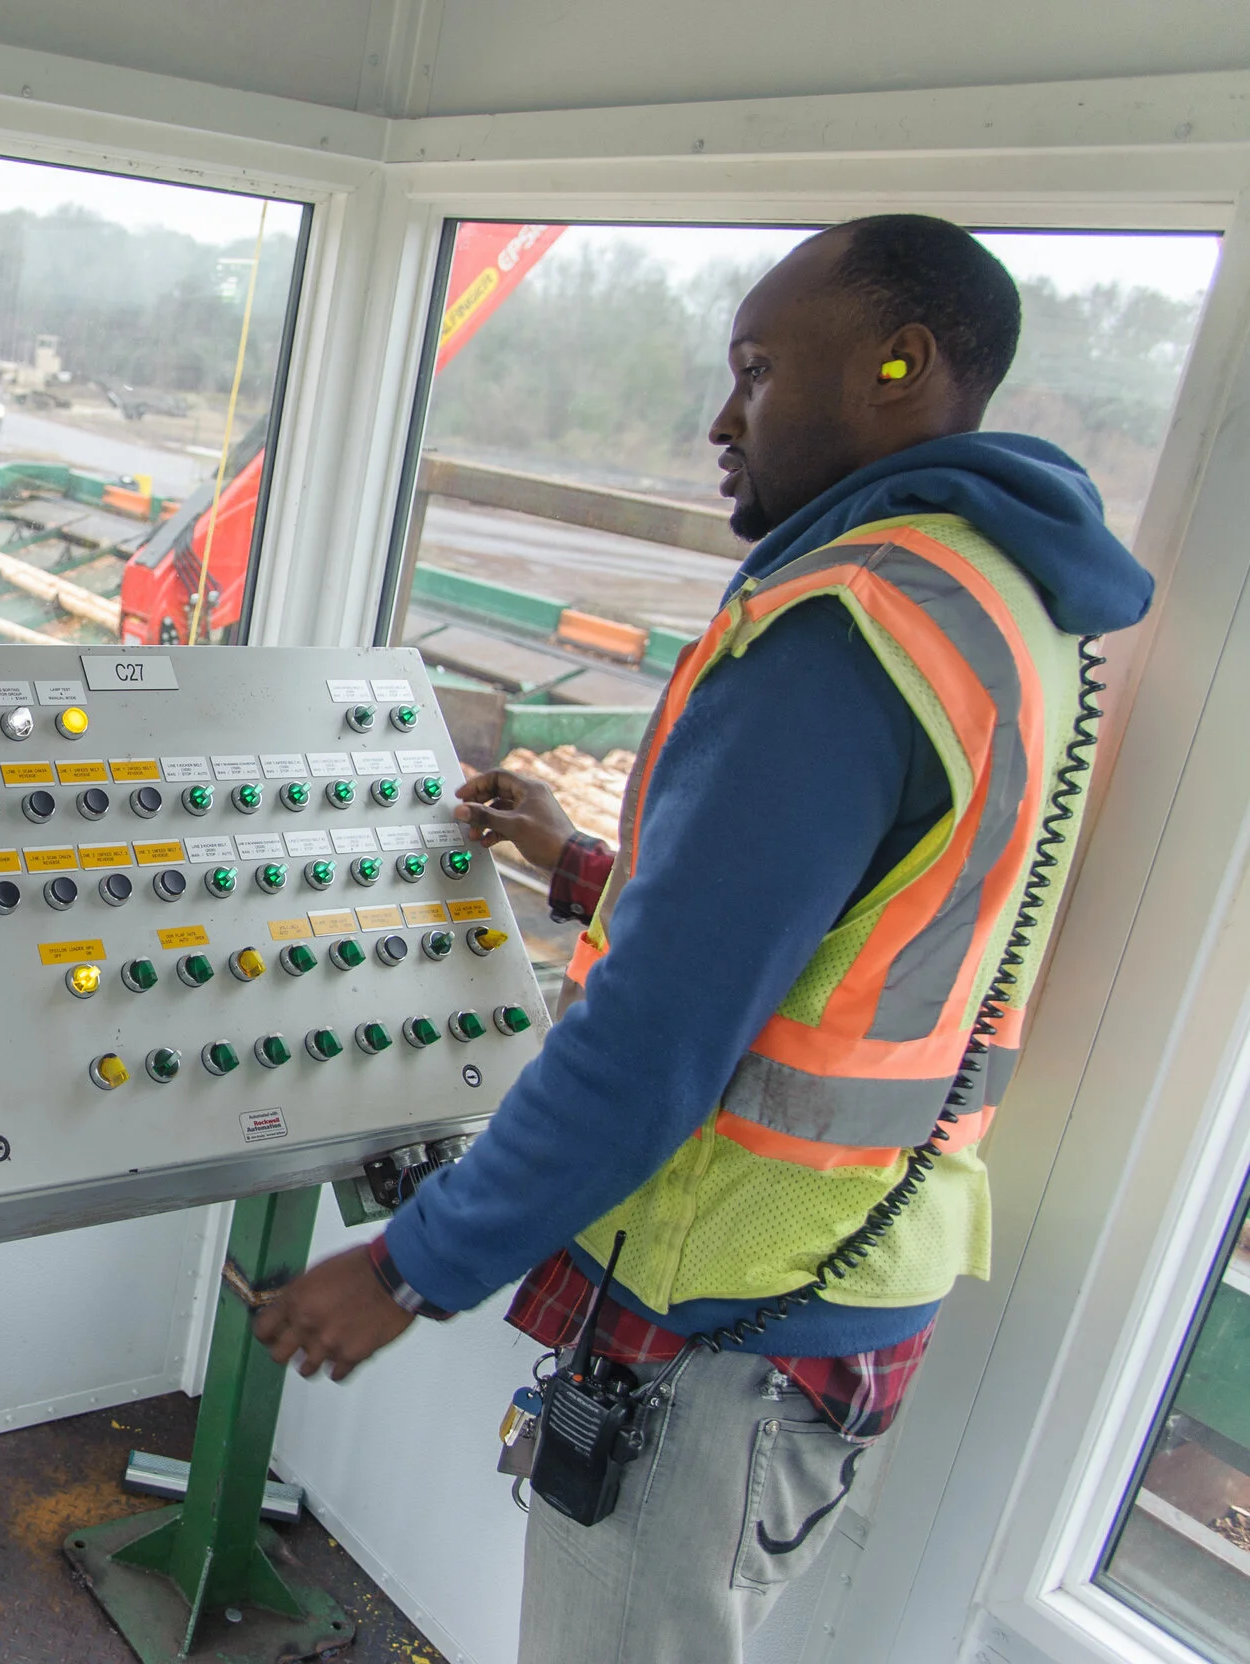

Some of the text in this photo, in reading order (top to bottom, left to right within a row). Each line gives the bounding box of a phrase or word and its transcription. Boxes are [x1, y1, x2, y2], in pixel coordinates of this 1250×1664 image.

[115, 664, 144, 681] C27
[253, 1116, 280, 1126] Rockwell
[246, 1123, 282, 1133] Automation
